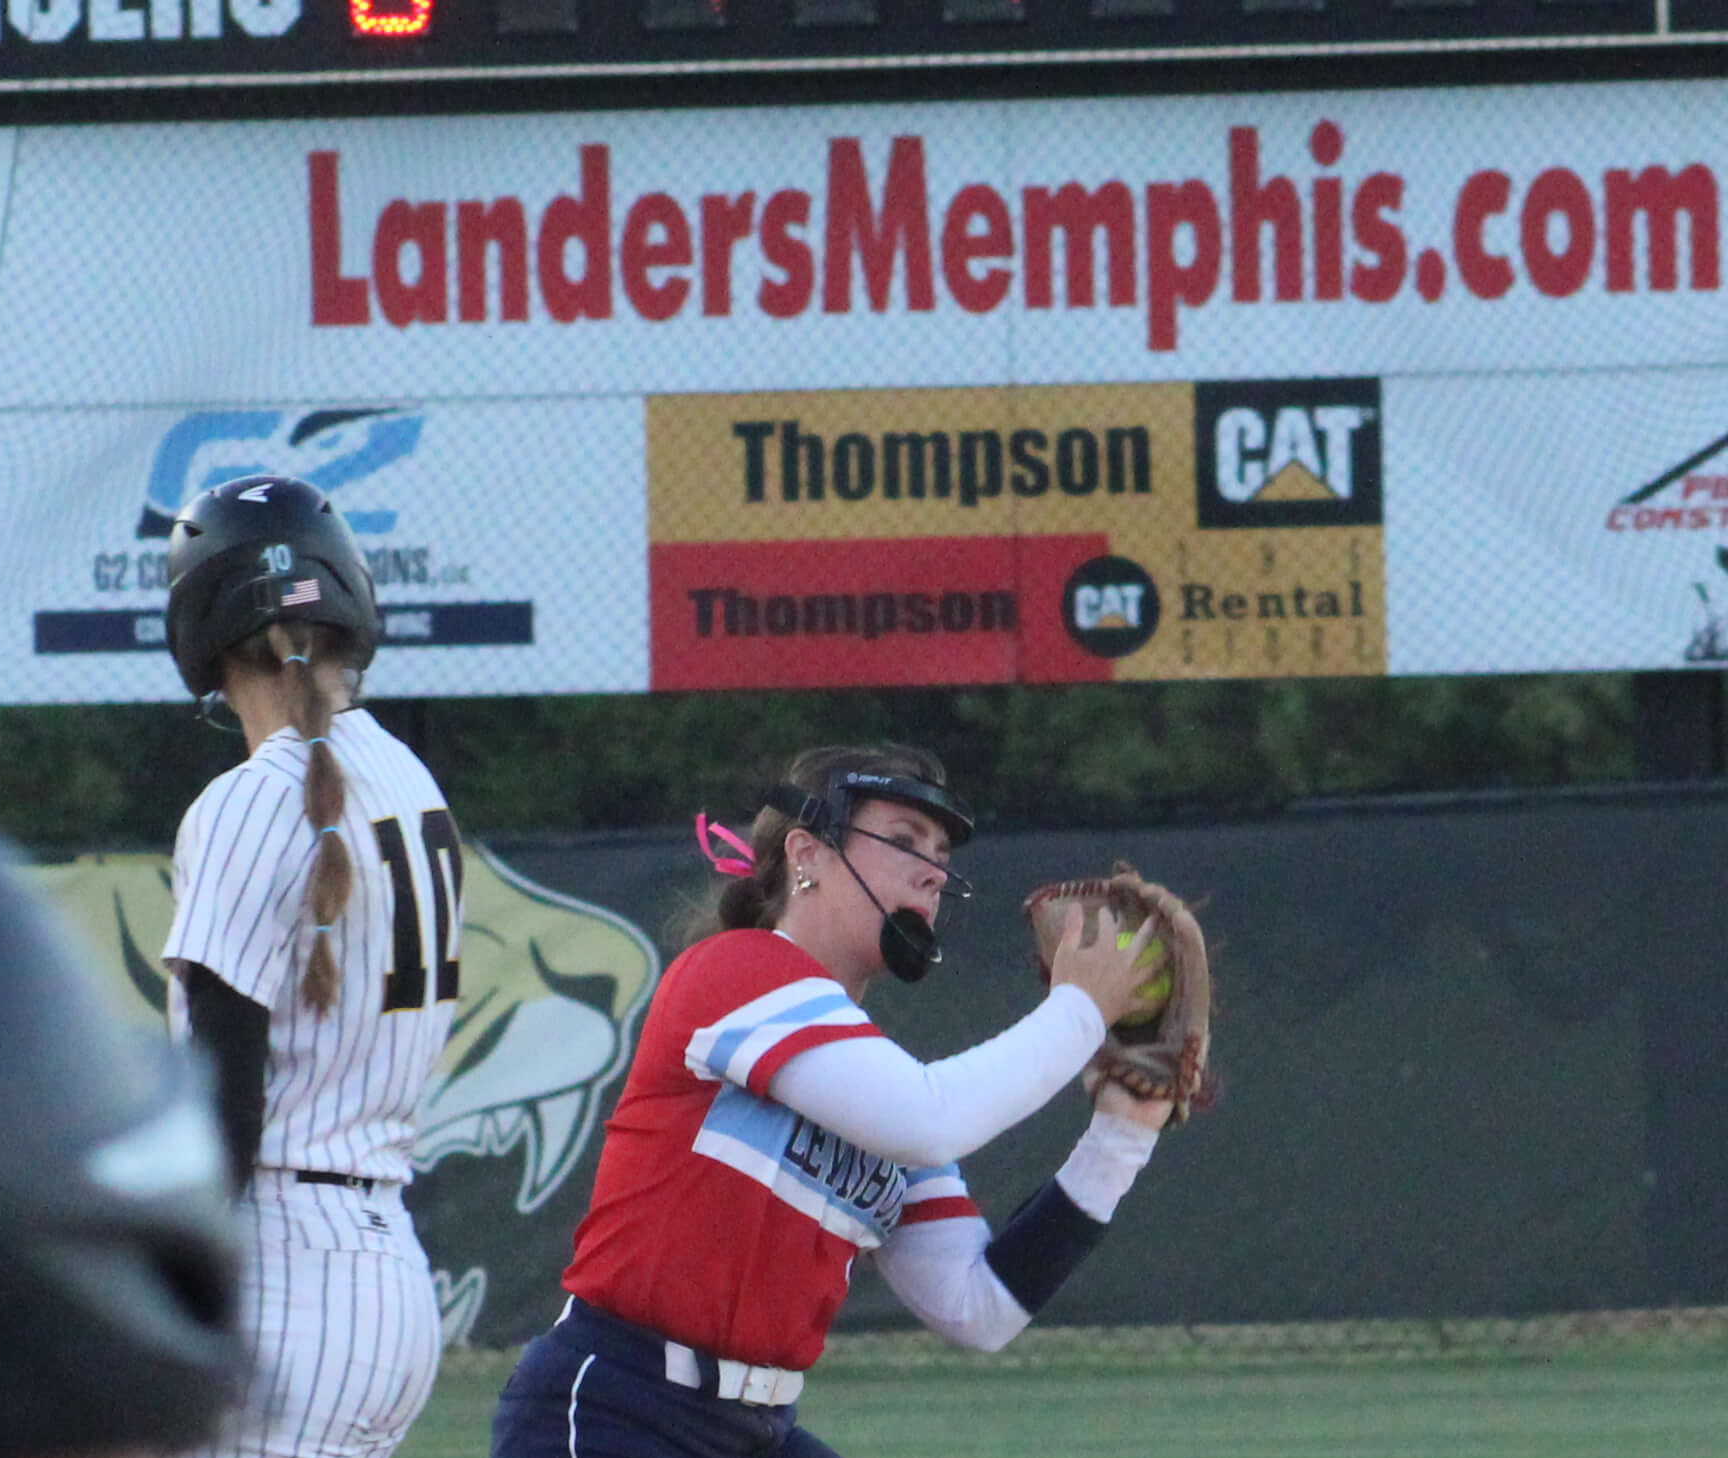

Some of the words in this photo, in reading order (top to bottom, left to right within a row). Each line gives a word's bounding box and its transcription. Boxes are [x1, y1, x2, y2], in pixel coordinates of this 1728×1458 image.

[307, 119, 1720, 352] LandersMemphis.com
[732, 421, 1153, 508] Thompson
[1215, 406, 1363, 503] CAT
[260, 544, 292, 574] 10
[687, 588, 1019, 640] Thompson
[1075, 584, 1144, 630] CAT
[1180, 581, 1366, 620] Rental
[371, 808, 465, 1014] 10
